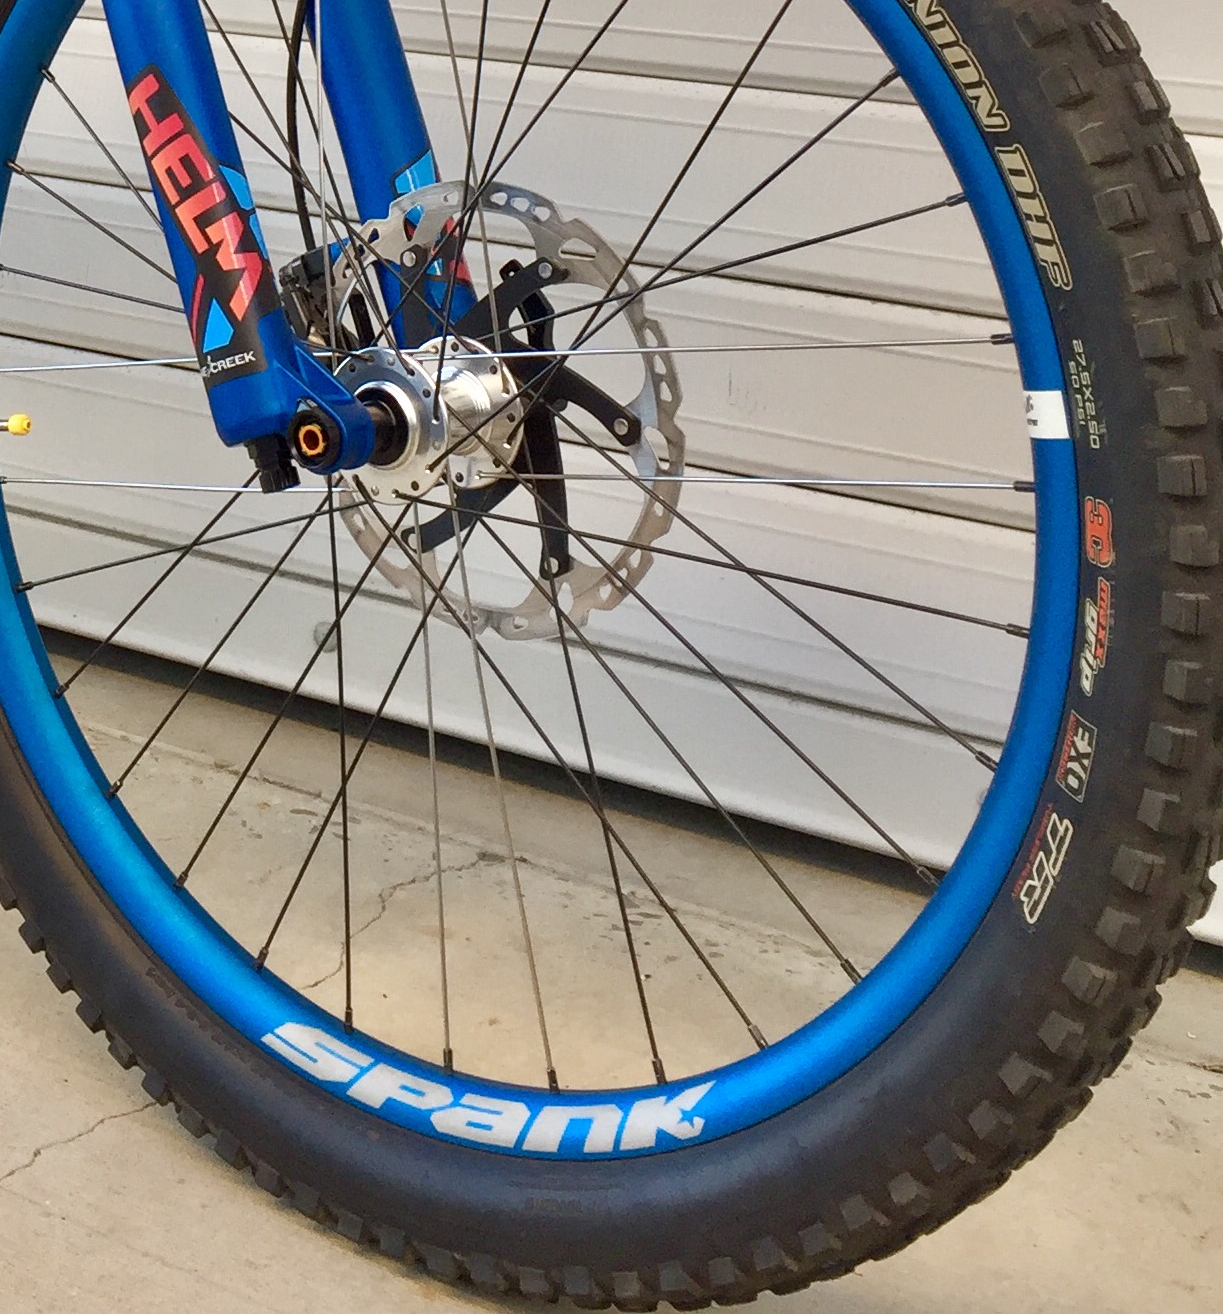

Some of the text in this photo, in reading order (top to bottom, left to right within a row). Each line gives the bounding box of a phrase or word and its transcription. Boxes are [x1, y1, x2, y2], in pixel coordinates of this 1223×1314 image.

[129, 73, 263, 322] HELM
[995, 144, 1073, 291] DHF
[209, 351, 256, 374] CREEK
[1064, 721, 1096, 798] EXO
